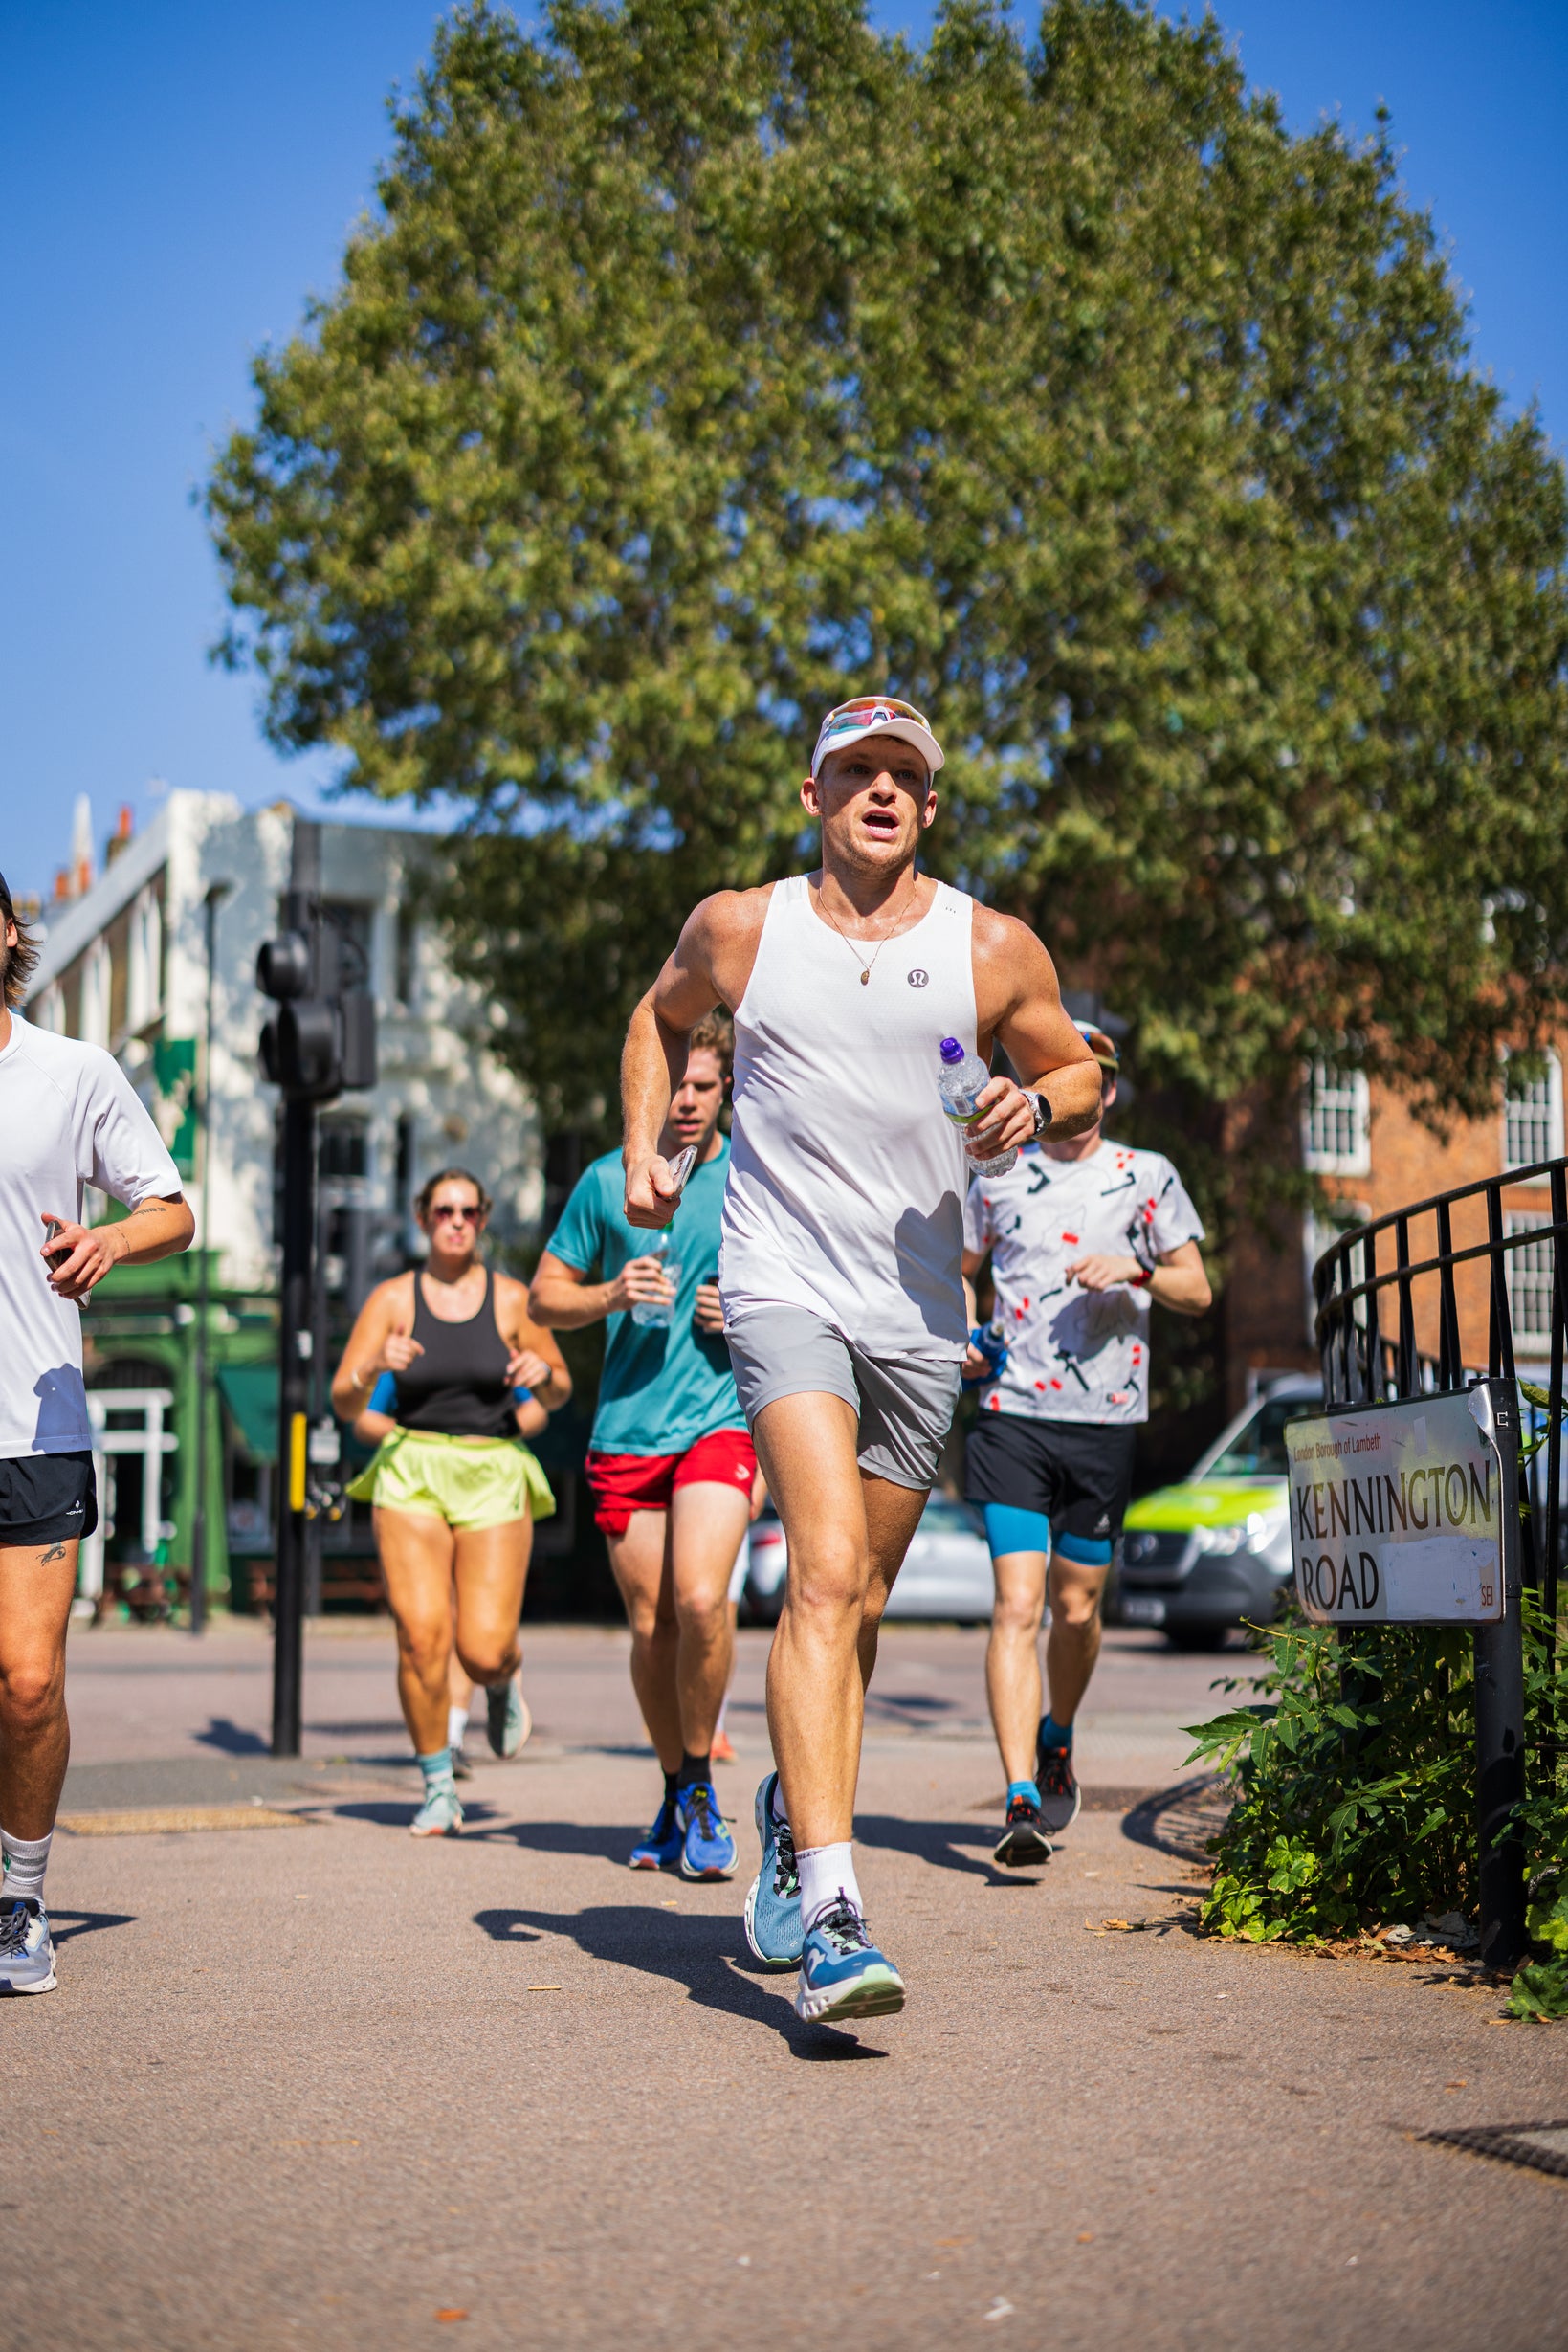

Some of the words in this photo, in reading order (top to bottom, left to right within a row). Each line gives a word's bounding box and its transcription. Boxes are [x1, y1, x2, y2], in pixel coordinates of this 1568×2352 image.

[1294, 1445, 1314, 1462] London
[1316, 1439, 1342, 1459] Borough
[1344, 1437, 1350, 1453] of
[1352, 1433, 1381, 1453] Lambeth
[1296, 1460, 1491, 1541] KENNINGTON
[1301, 1552, 1379, 1610] ROAD
